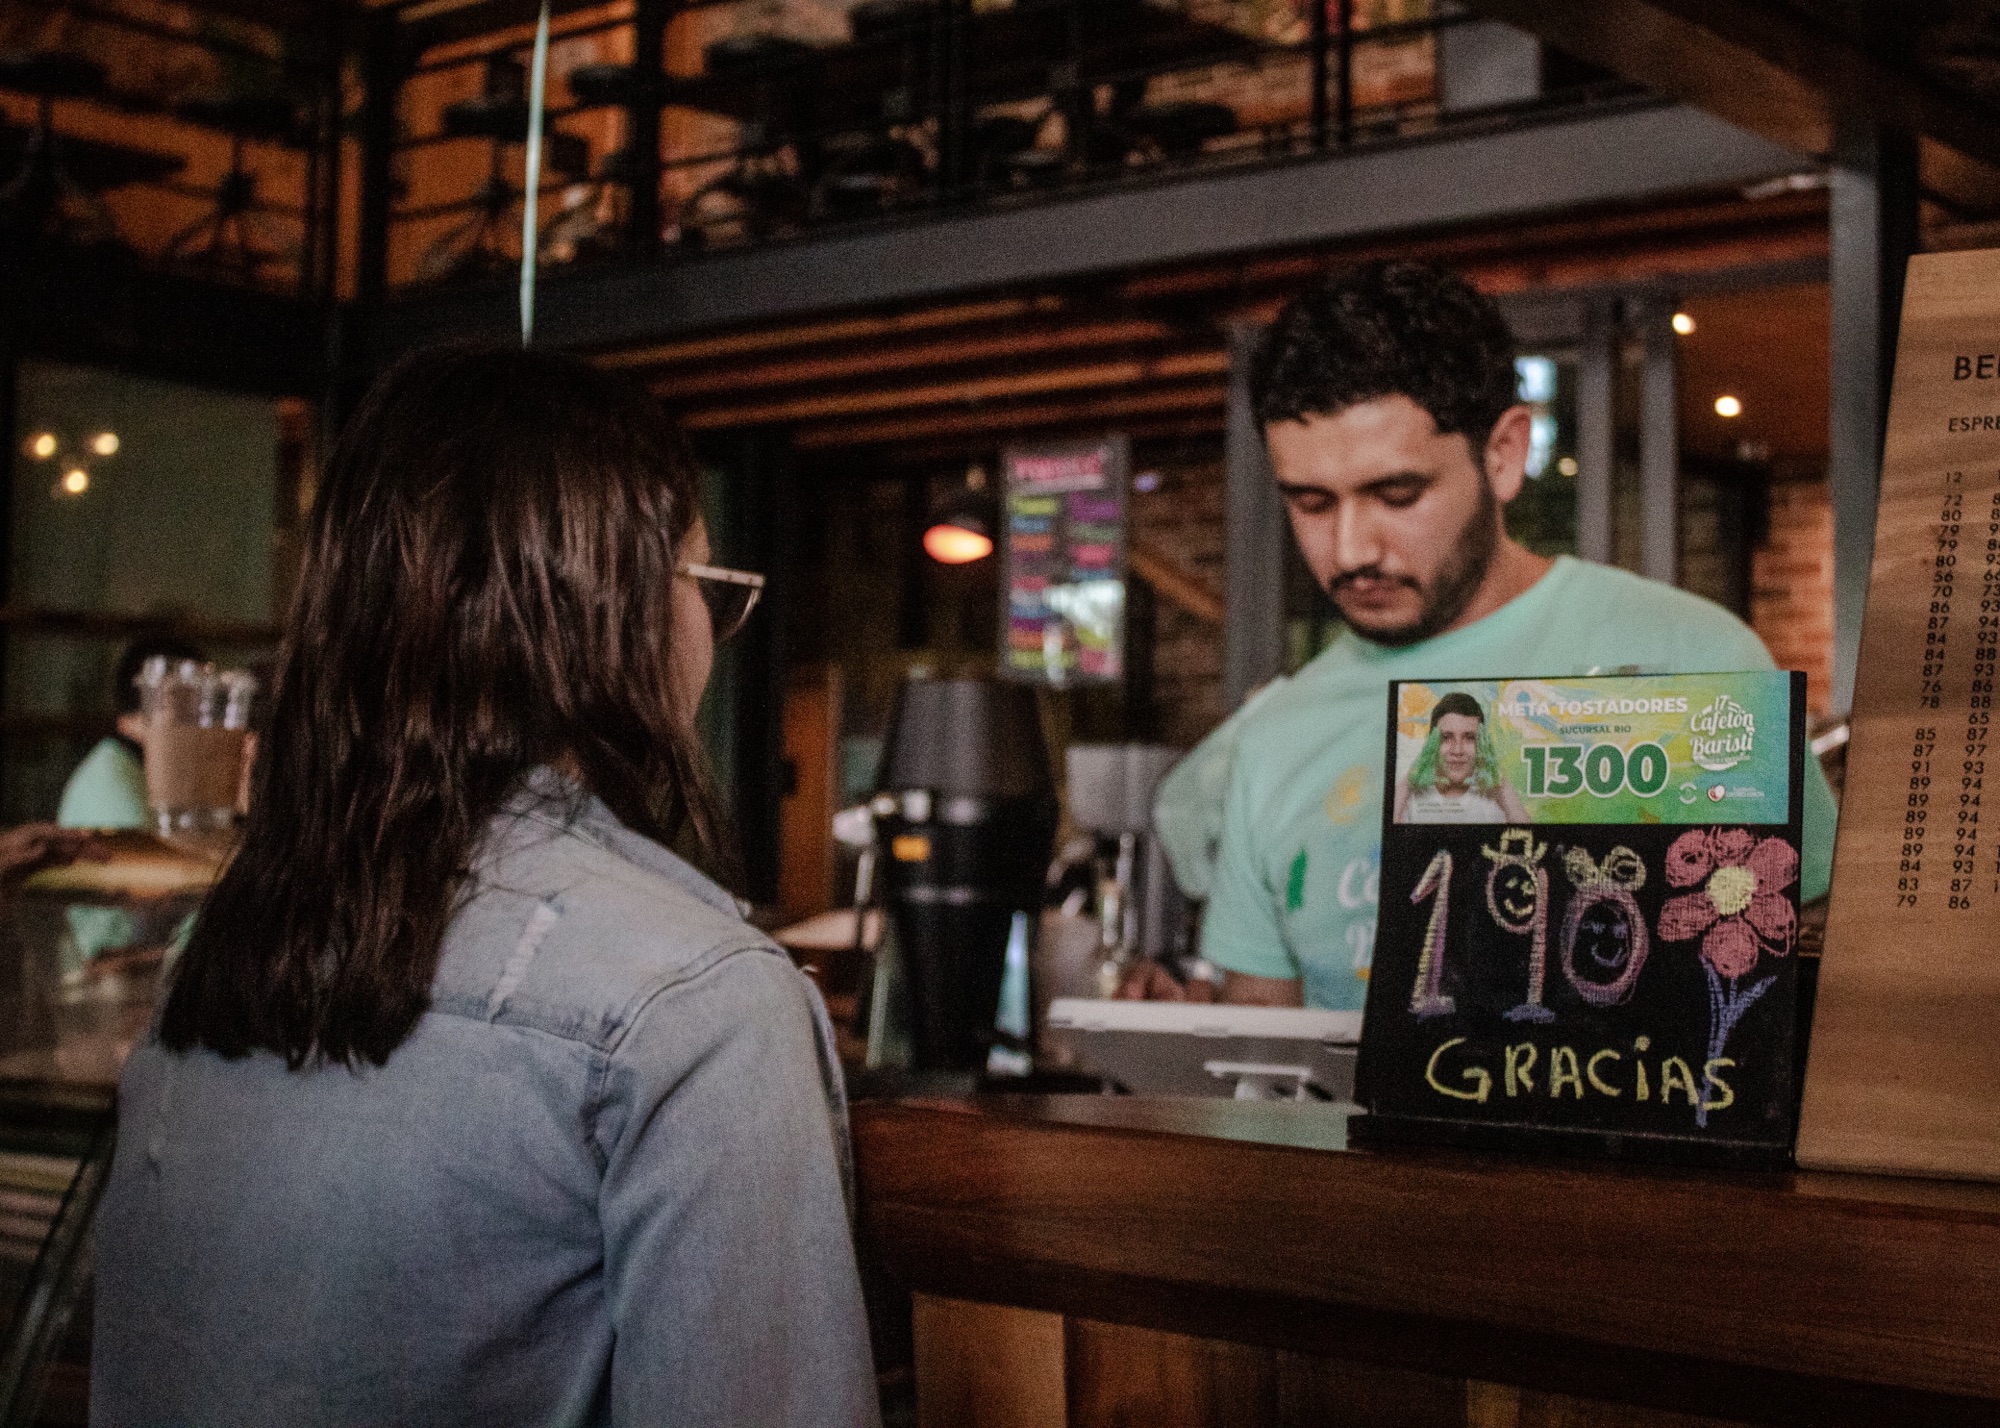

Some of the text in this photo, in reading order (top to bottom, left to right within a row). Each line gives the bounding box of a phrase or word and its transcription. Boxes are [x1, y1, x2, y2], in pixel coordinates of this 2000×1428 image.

[1954, 354, 2000, 380] BE
[1942, 510, 1961, 521] 80
[1940, 525, 1959, 536] 79
[1936, 554, 1956, 567] 80
[1932, 585, 1952, 597] 70
[1930, 600, 2000, 613] 86 93
[1928, 616, 1999, 629] 87 94
[1926, 632, 1998, 645] 84 93
[1925, 649, 1944, 660] 84
[1923, 663, 1995, 677] 87 93
[1498, 698, 1689, 717] META TOSTADORES
[1921, 696, 1991, 709] 78 88
[1969, 712, 1989, 724] 65
[1559, 725, 1610, 736] SUCURSAL
[1916, 728, 1988, 741] 85 87
[1914, 744, 1986, 757] 87 97
[1521, 740, 1671, 798] 1300
[1912, 761, 1984, 774] 91 93
[1910, 777, 1982, 790] 89 94
[1908, 794, 1980, 807] 89 94
[1906, 810, 1979, 824] 89 94
[1904, 827, 1977, 840] 89 94
[1902, 843, 1975, 857] 89 94
[1900, 860, 1920, 872] 84
[1953, 860, 1974, 874] 93
[1898, 877, 1919, 891] 83
[1951, 879, 1972, 892] 87
[1897, 895, 1970, 909] 79 86
